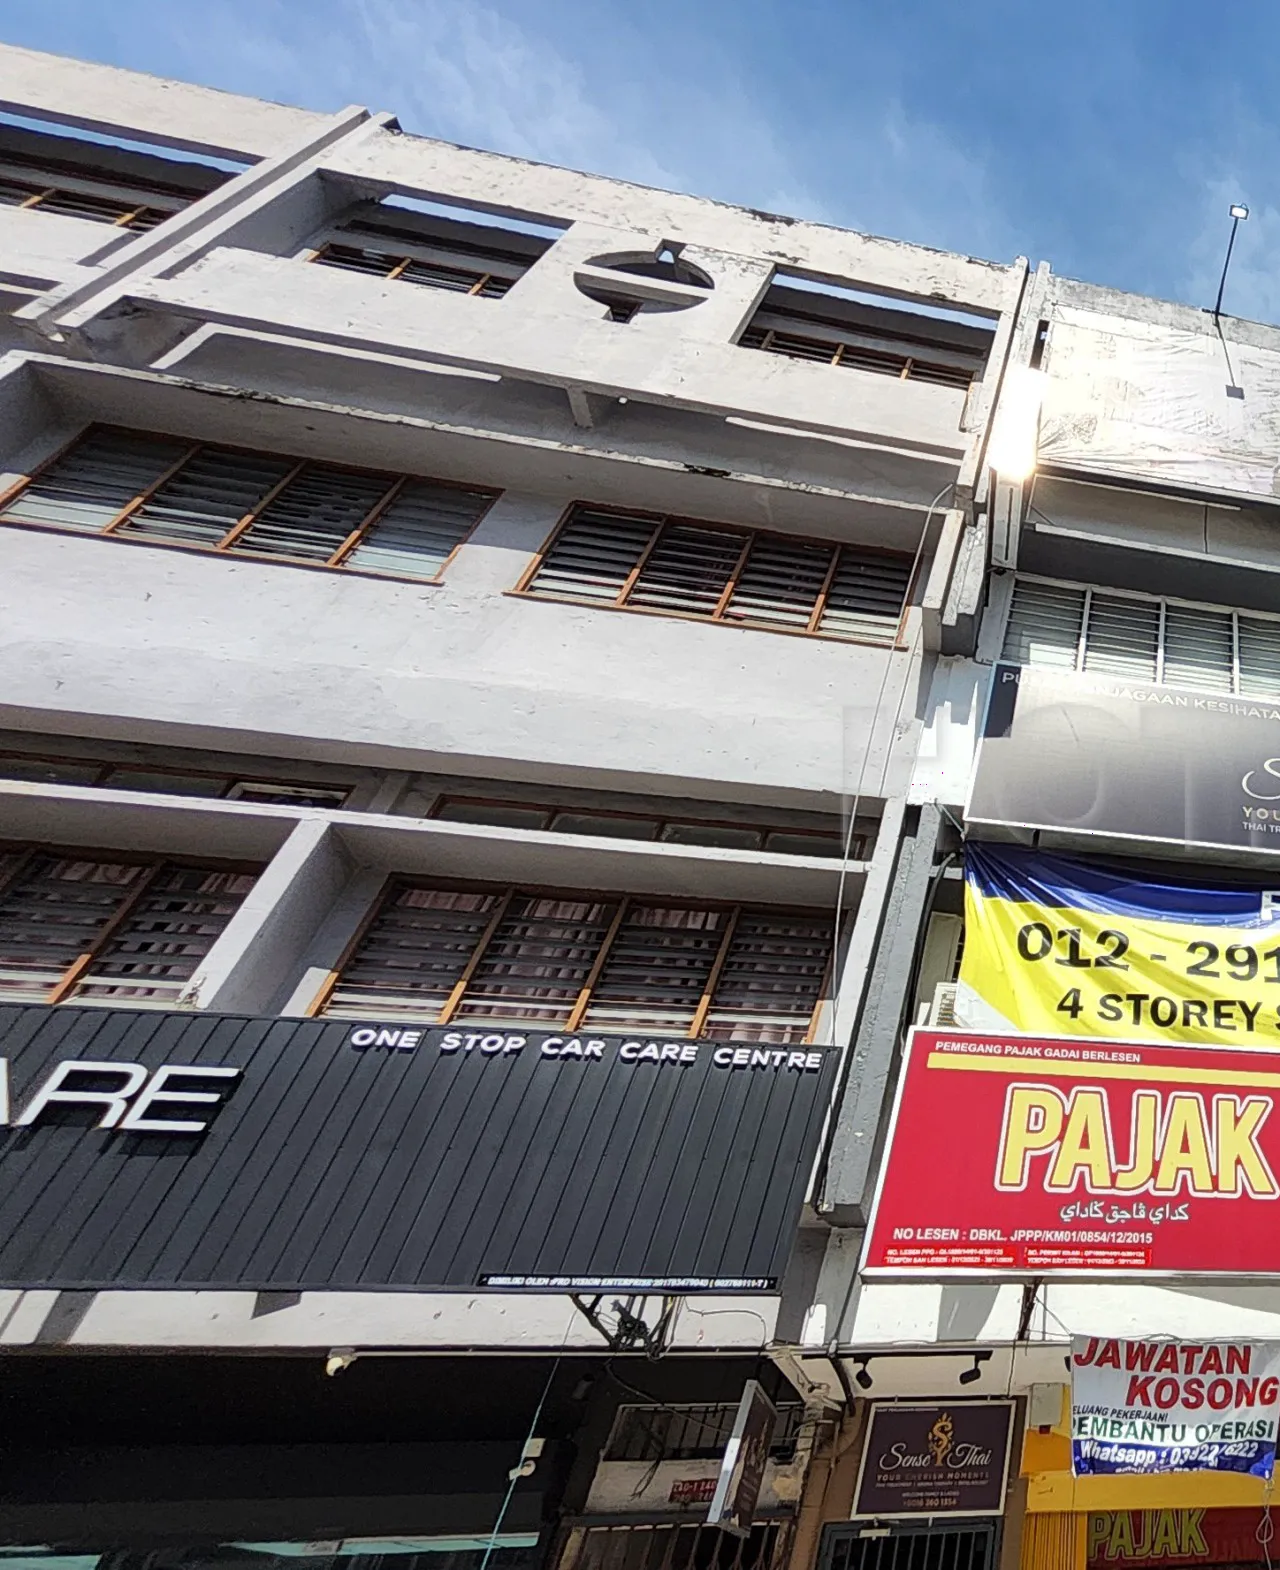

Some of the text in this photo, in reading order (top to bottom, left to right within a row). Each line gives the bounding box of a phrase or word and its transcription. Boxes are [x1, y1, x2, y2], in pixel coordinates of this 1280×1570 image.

[1242, 821, 1267, 833] THAI
[1017, 922, 1130, 971] 012
[1057, 987, 1084, 1020] 4
[1097, 993, 1262, 1032] STOREY
[350, 1028, 822, 1070] ONE STOP CAR CARE CENTRE
[935, 1040, 1141, 1064] PEMEGANG PAJAK GADAI BERLESEN
[0, 1057, 243, 1132] RE
[993, 1083, 1280, 1200] PAJAK
[893, 1228, 914, 1240] NO
[916, 1228, 959, 1241] LESEN
[1073, 1337, 1252, 1376] JAWATAN
[1125, 1374, 1280, 1410] KOSONG
[1195, 1419, 1275, 1443] OPERASI
[946, 1442, 992, 1468] Thai
[1080, 1440, 1156, 1467] Whatsapp
[1087, 1508, 1209, 1561] PAJAK
